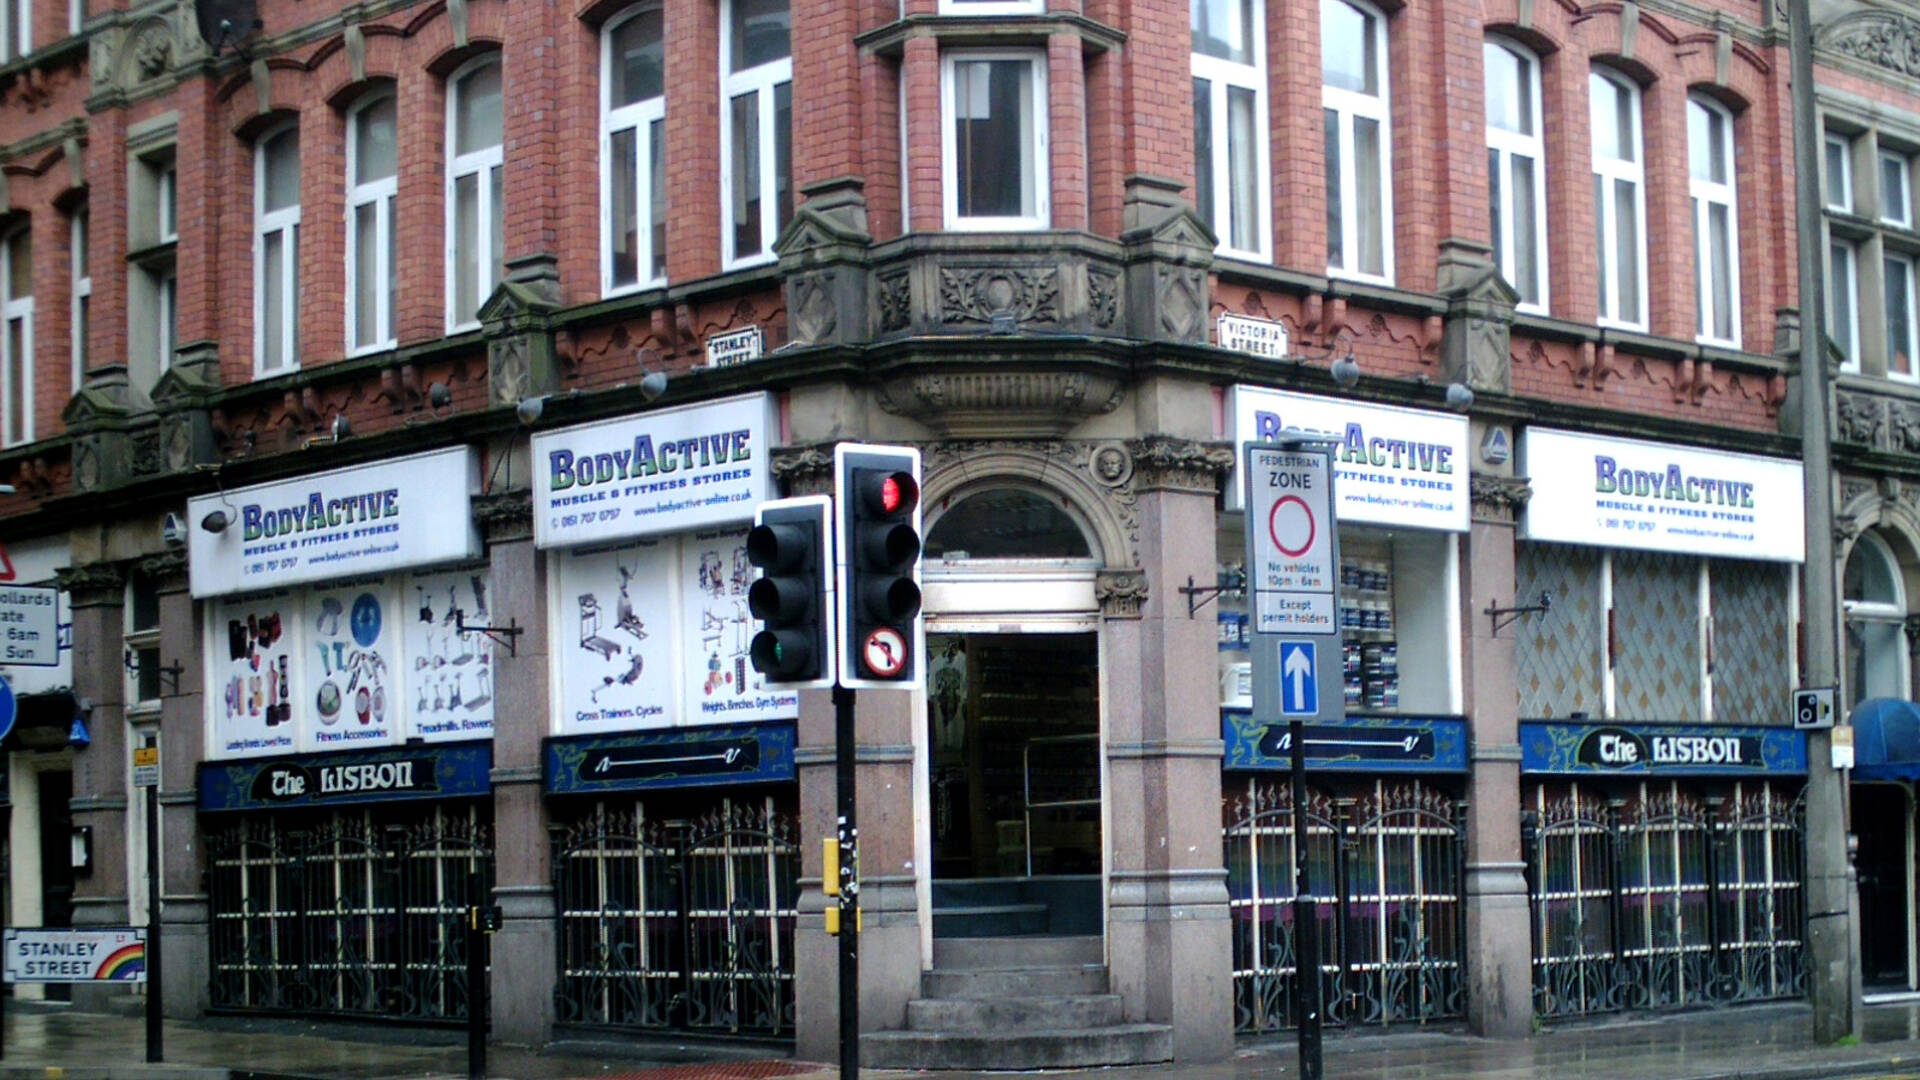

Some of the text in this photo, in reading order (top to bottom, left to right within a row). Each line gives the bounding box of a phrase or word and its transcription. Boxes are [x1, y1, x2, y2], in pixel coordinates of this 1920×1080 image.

[1229, 322, 1278, 340] VICTORIA
[713, 335, 753, 353] STANLEY
[1231, 338, 1275, 355] STREET
[716, 351, 751, 369] STREET
[1255, 410, 1453, 474] BACTIVE
[549, 429, 751, 492] BODYACTIVE
[1259, 455, 1320, 468] PEDESTRIAN
[551, 489, 606, 508] MUSCLE
[625, 479, 687, 497] FITNESS
[693, 469, 751, 486] STORES
[1270, 471, 1312, 489] ZONE
[1401, 478, 1453, 491] STORES
[1595, 455, 1754, 508] BODYACTIVE
[242, 488, 400, 542] BODYACTIVE
[1596, 500, 1644, 512] MUSCLE
[1659, 506, 1708, 518] FITNESS
[1712, 511, 1755, 523] STORES
[244, 541, 287, 557] MUSCLE
[301, 531, 350, 547] FITNESS
[354, 523, 400, 538] STORES
[1268, 561, 1320, 574] No vehicles
[1268, 575, 1293, 587] 10pm
[1301, 575, 1322, 586] 6am
[1280, 599, 1312, 611] Except
[1262, 614, 1329, 624] permit holders
[7, 627, 40, 641] 6am
[6, 645, 35, 659] Sun
[576, 710, 599, 722] Cross
[636, 705, 664, 718] Cycles
[462, 719, 494, 731] Rowers
[316, 728, 388, 743] Fitness Accessories
[1600, 735, 1743, 763] The LISBON
[271, 761, 414, 796] The LISBON
[19, 942, 98, 956] STANLEY
[25, 961, 92, 975] STREET
